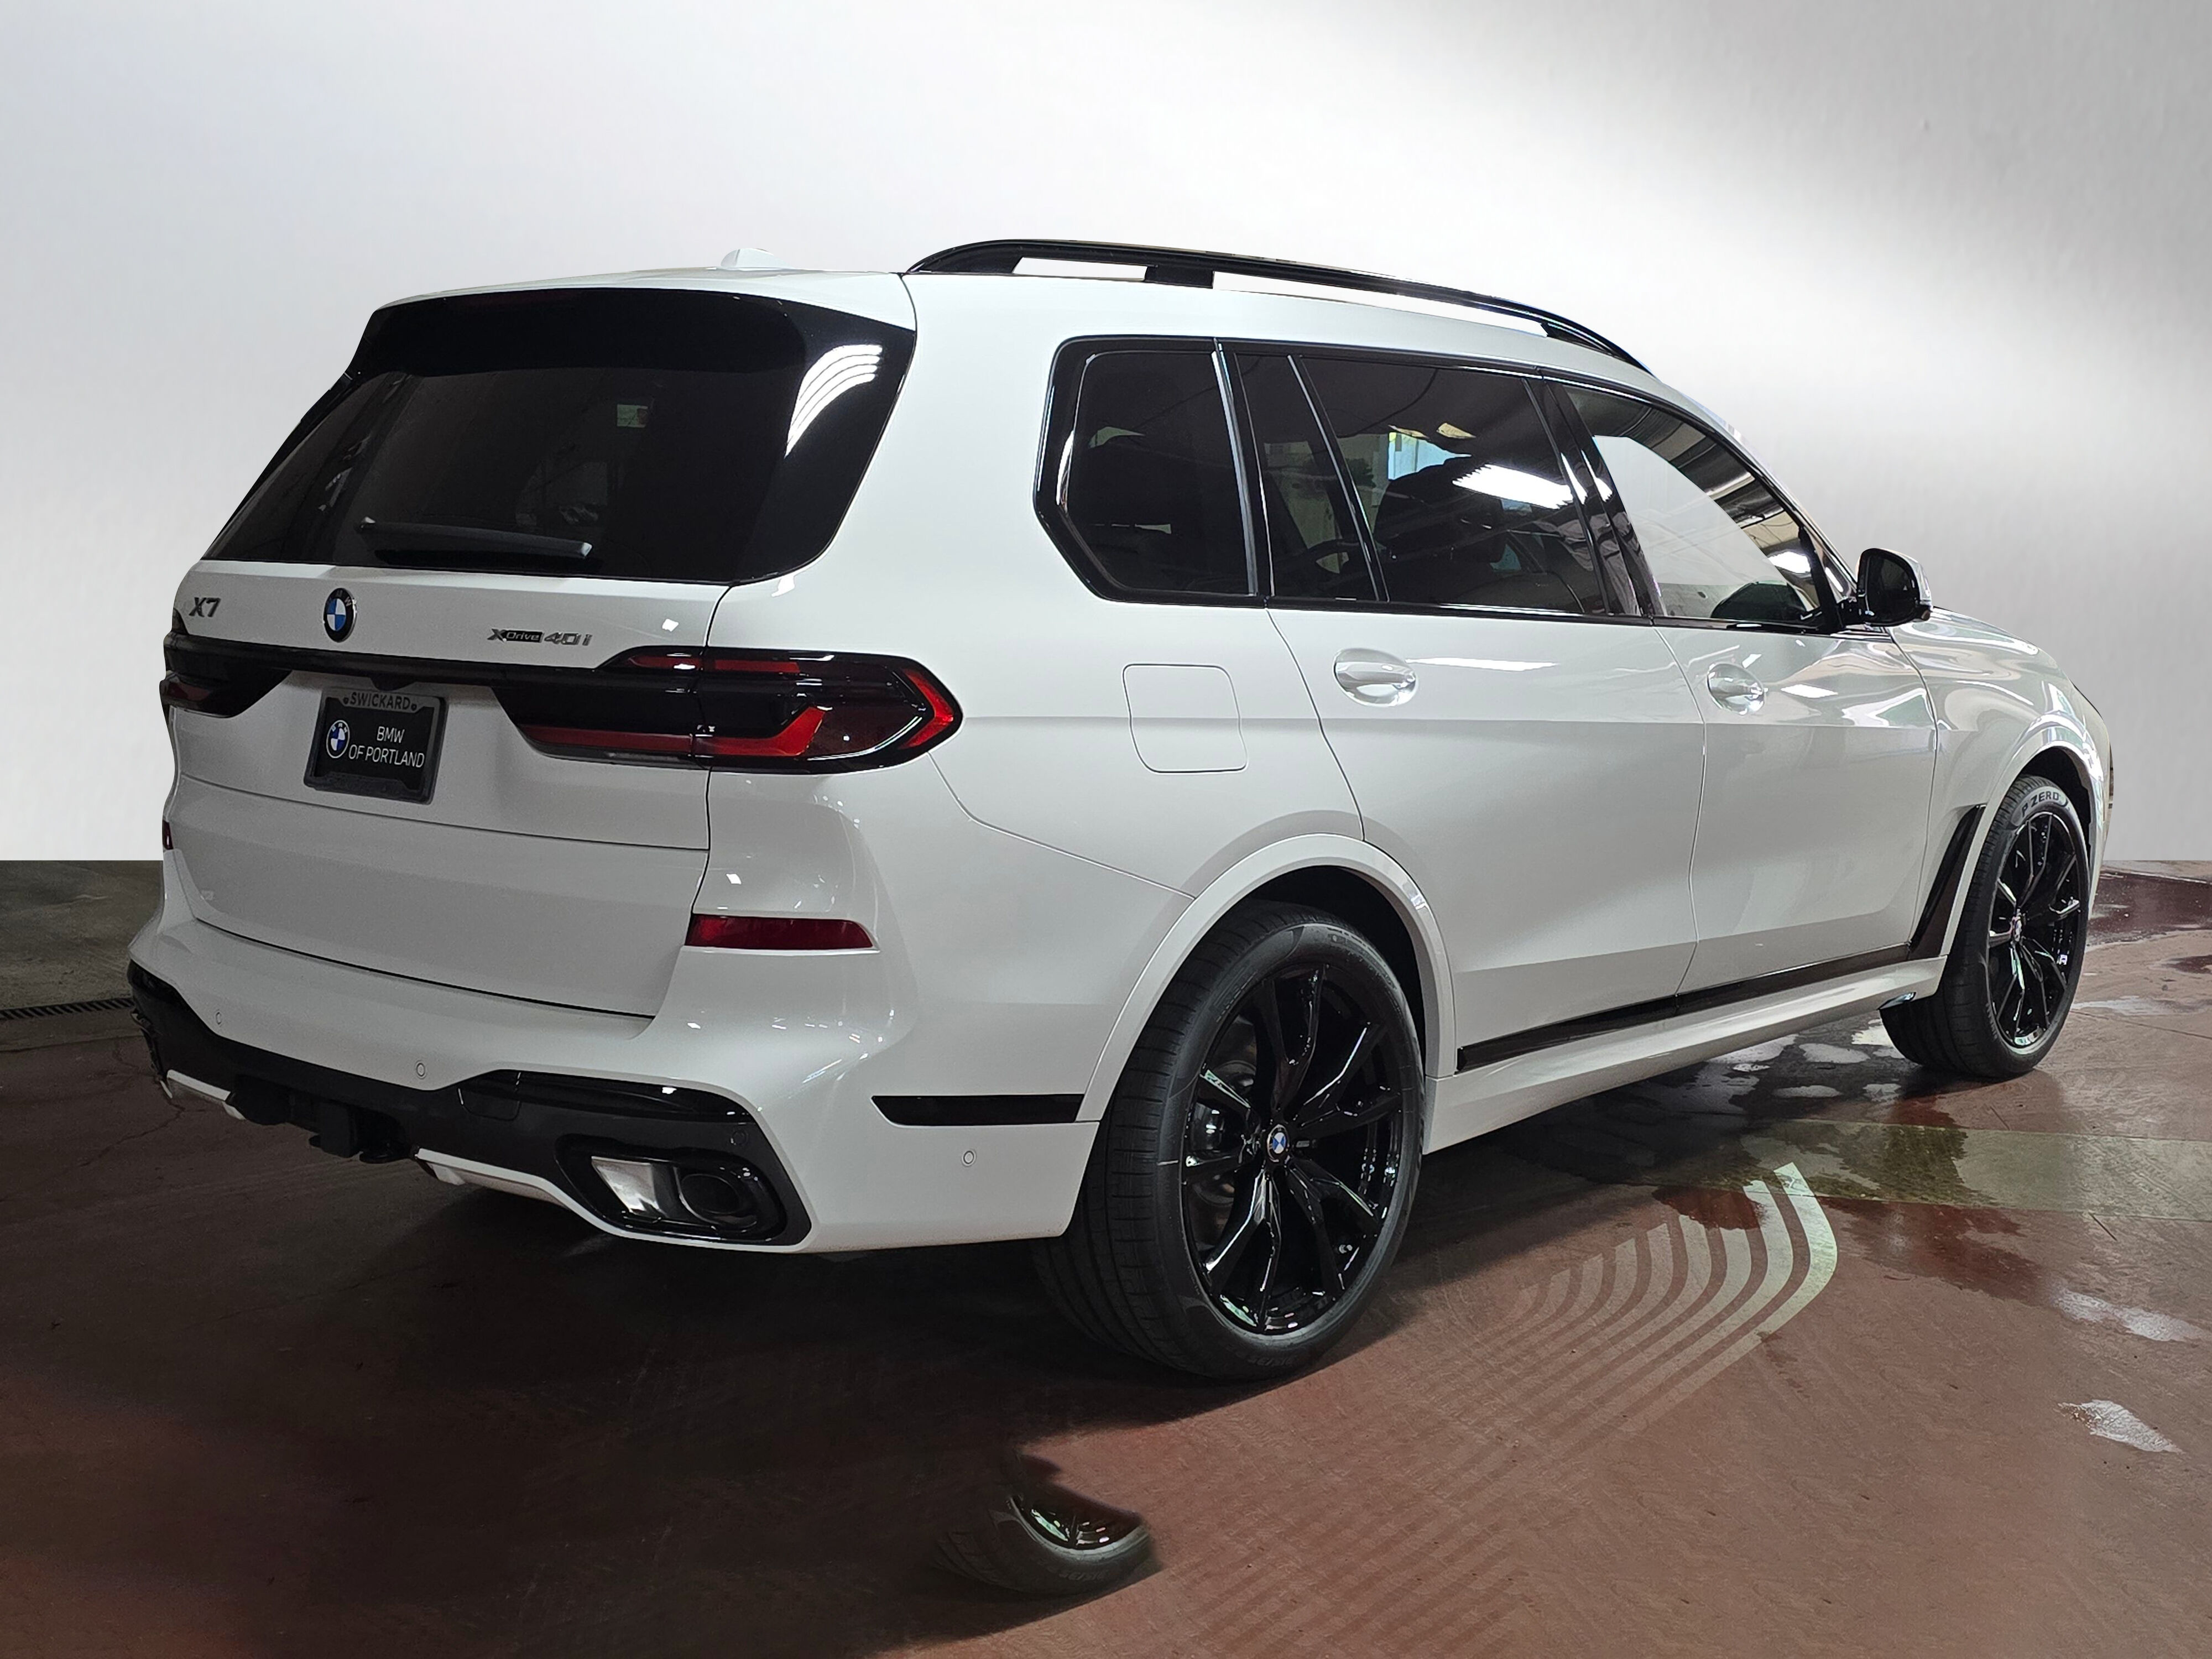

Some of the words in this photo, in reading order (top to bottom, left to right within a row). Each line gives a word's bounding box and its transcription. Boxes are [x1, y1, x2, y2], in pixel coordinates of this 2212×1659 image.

[189, 597, 221, 617] X7
[350, 692, 410, 710] SWICKARD
[377, 726, 405, 743] BMW
[348, 744, 365, 759] OF
[365, 747, 425, 768] PORTLAND
[2022, 803, 2028, 817] P
[2031, 790, 2059, 807] ZERO
